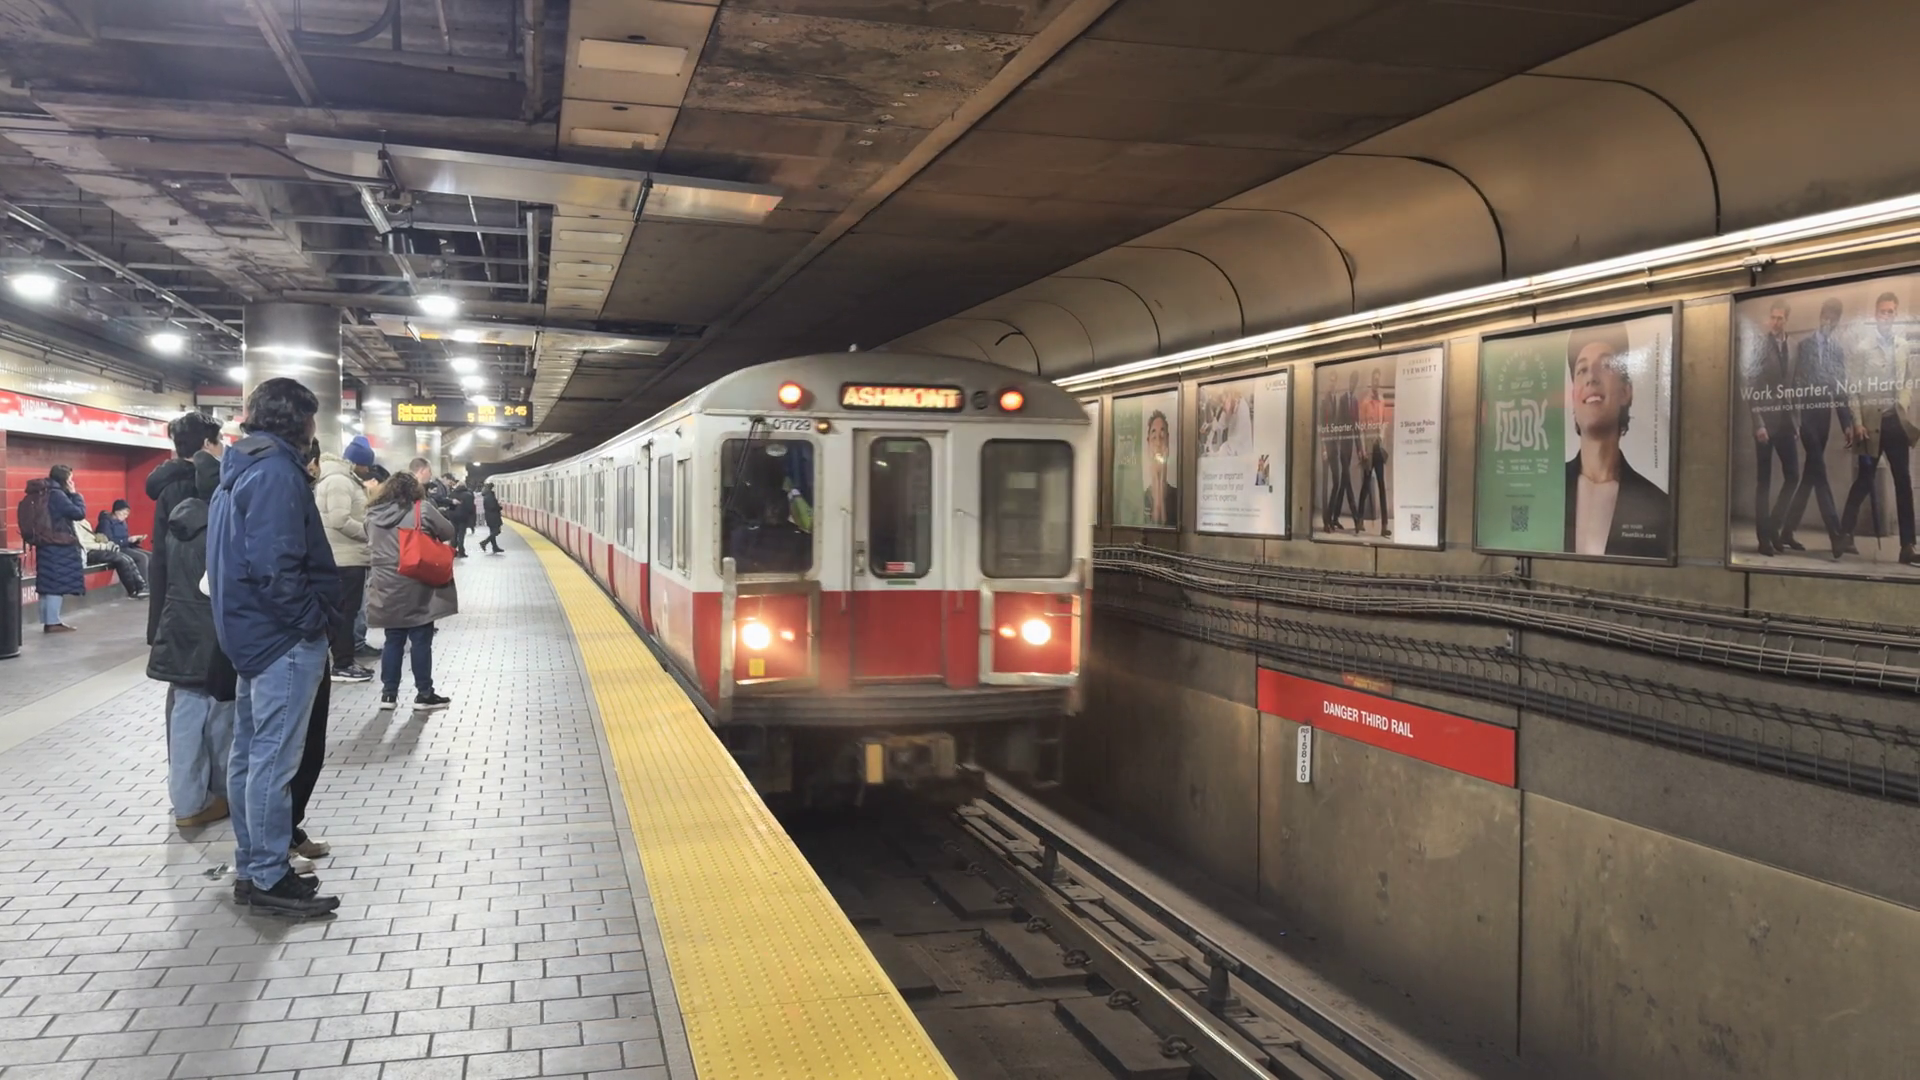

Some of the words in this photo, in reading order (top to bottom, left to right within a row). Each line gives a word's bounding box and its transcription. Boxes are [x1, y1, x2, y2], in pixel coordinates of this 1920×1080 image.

[842, 386, 961, 408] ASHMONT
[1740, 384, 1773, 401] Work
[1776, 383, 1832, 399] Smarter.
[1835, 378, 1862, 395] Not
[504, 405, 527, 416] 2:45
[1783, 404, 1793, 412] FOR
[467, 412, 475, 422] 5
[773, 419, 811, 431] 01729
[1495, 398, 1549, 451] FLOOK
[1323, 700, 1359, 723] DANGER
[1360, 710, 1389, 731] THIRD
[1391, 718, 1414, 738] RAIL
